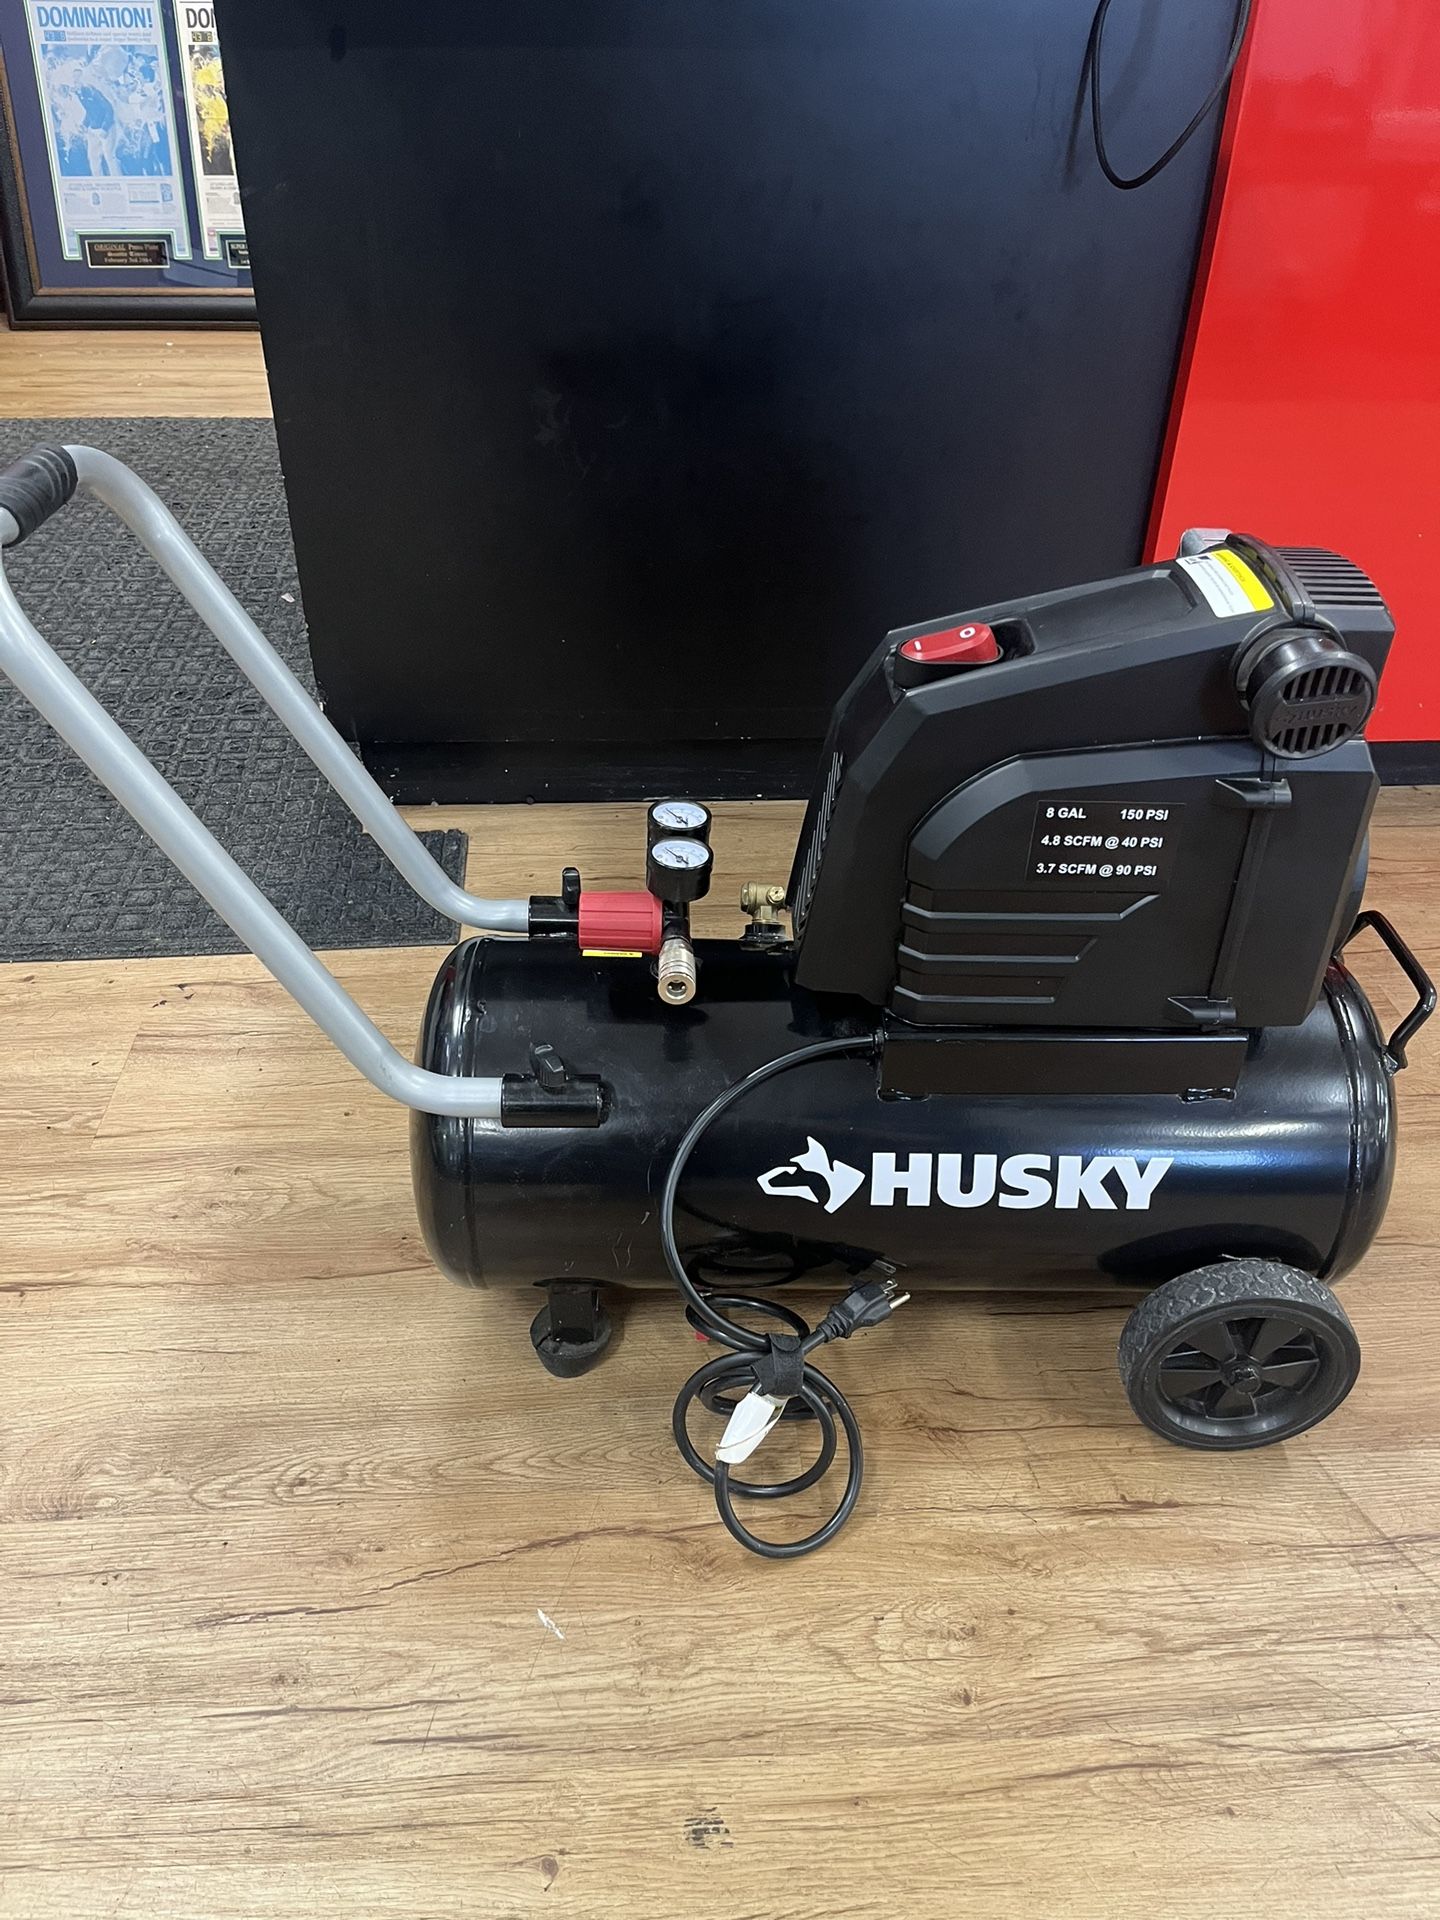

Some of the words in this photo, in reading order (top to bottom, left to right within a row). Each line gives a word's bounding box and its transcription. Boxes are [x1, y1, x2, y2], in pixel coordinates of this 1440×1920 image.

[37, 6, 152, 28] DOMINATION!
[185, 7, 215, 28] DO
[1046, 807, 1055, 818] 8
[1058, 808, 1087, 819] GAL
[1120, 809, 1143, 820] 150
[1145, 809, 1169, 821] PSI
[1041, 835, 1061, 846] 4.8
[1063, 835, 1103, 847] SCFM
[1104, 836, 1119, 849] @
[1121, 837, 1138, 848] 40
[1140, 837, 1163, 848] PSI
[1036, 863, 1056, 874] 3.7
[1058, 864, 1097, 875] SCFM
[1099, 865, 1114, 877] @
[1115, 865, 1131, 875] 90
[1134, 865, 1157, 876] PSI
[870, 1152, 1175, 1210] HUSKY
